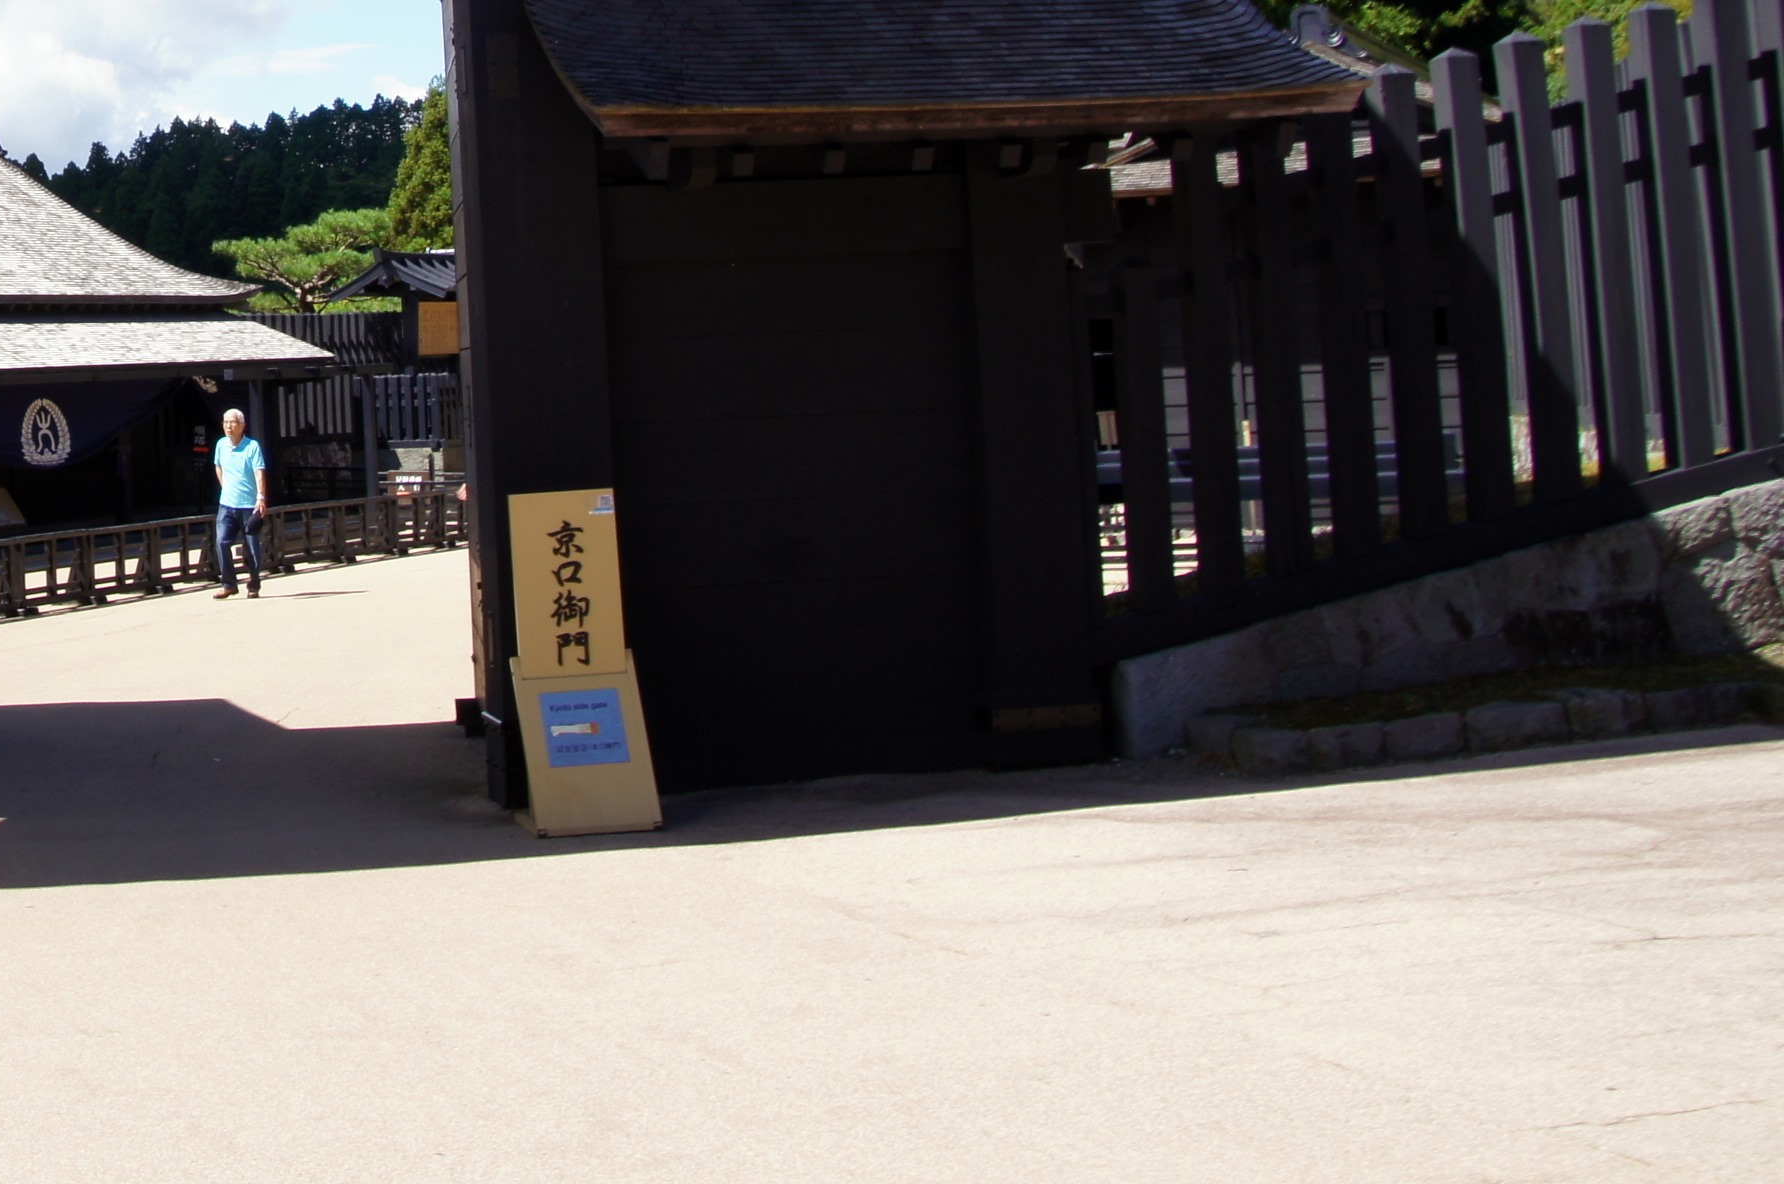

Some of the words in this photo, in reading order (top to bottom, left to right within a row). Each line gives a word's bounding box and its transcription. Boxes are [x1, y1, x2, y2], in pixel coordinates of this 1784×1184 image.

[547, 520, 590, 666] 京口御門
[549, 704, 572, 713] Kyoto
[590, 702, 608, 711] gate
